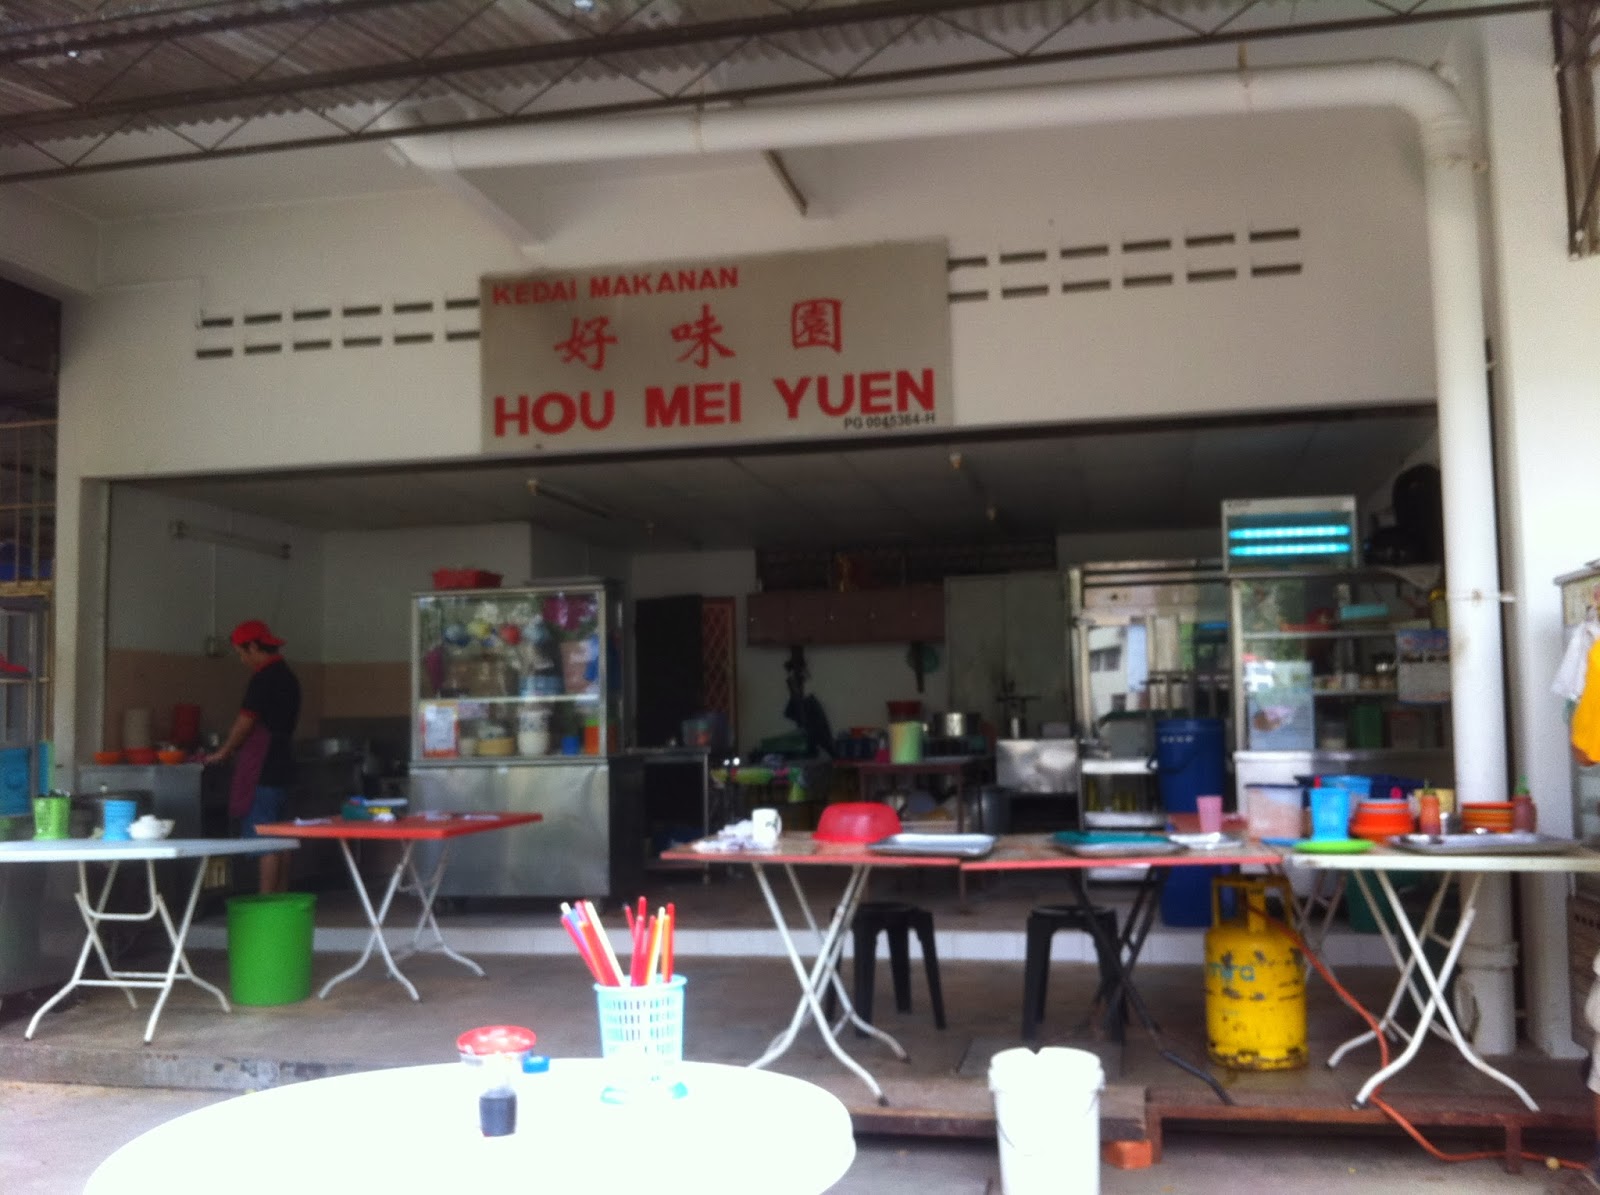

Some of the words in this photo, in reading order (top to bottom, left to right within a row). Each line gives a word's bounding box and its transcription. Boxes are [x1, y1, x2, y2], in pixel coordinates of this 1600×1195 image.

[491, 278, 578, 305] KEDAI
[588, 266, 741, 299] MAKANAN
[493, 388, 617, 438] HOU
[643, 379, 744, 429] MEI
[772, 367, 937, 421] YUEN
